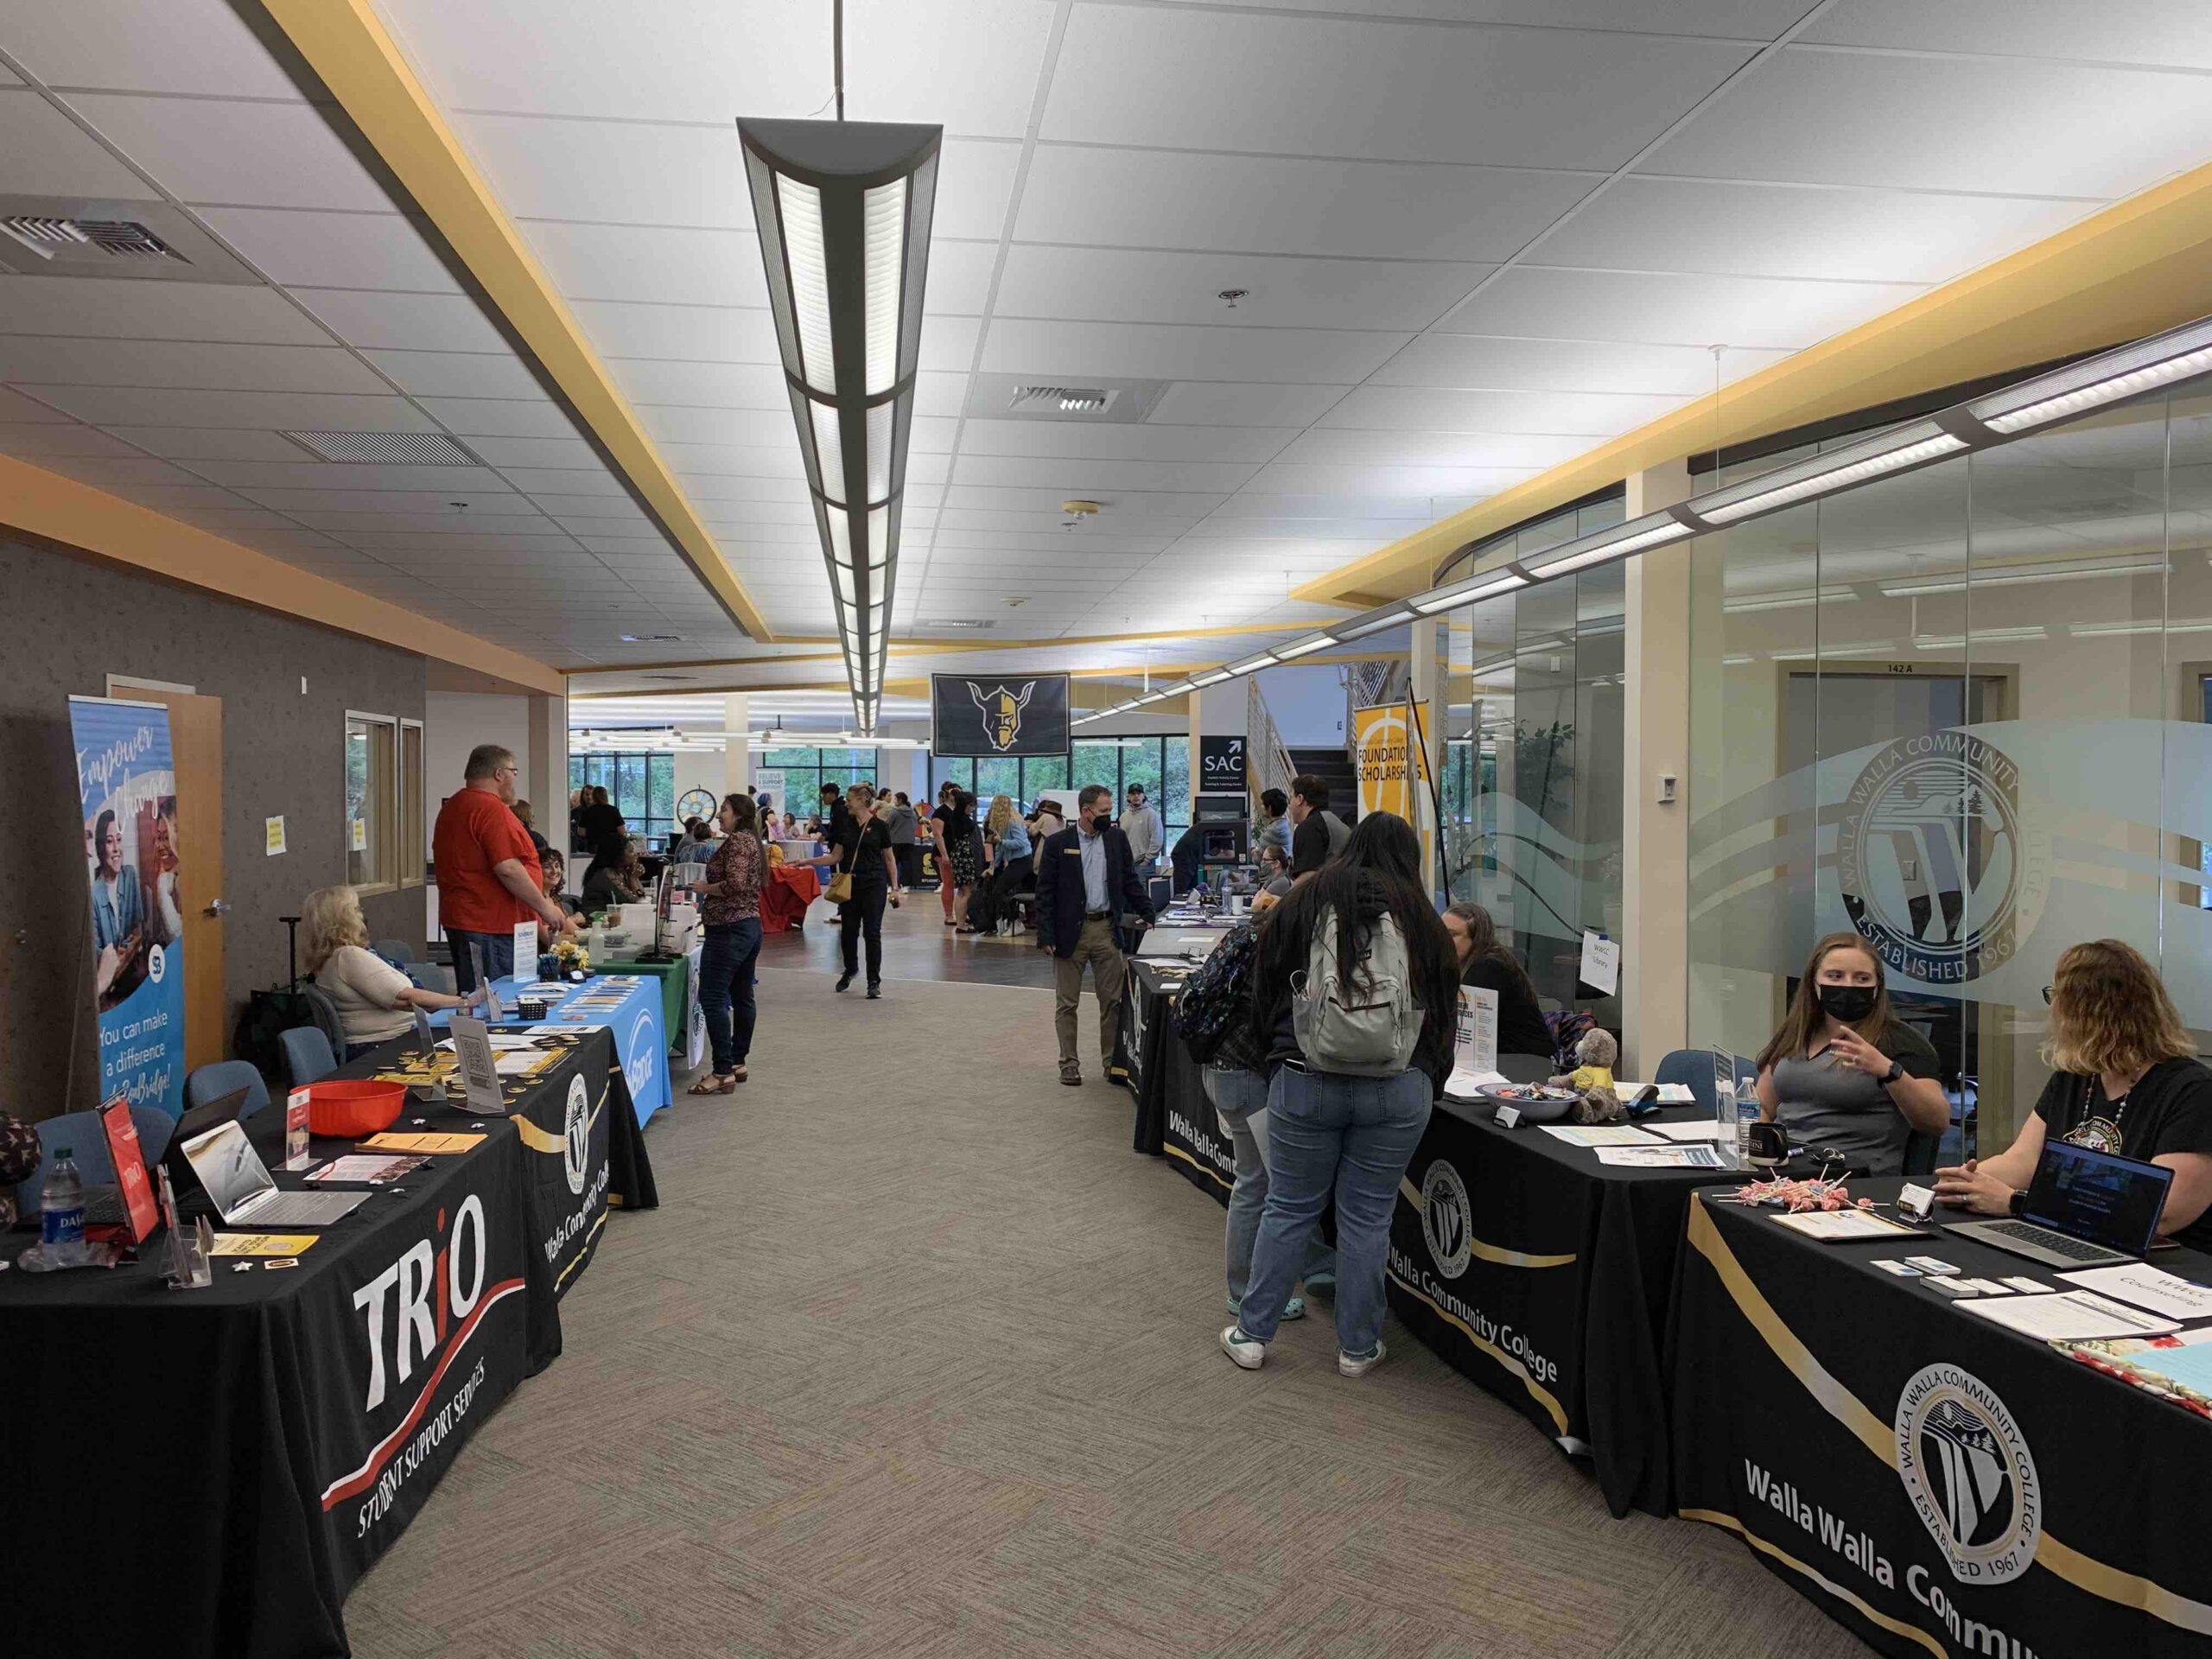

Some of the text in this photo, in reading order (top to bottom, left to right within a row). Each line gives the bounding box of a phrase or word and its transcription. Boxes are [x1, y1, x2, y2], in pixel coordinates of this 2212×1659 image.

[1205, 755, 1243, 772] SAC
[1358, 764, 1422, 781] SCHOLARSHS
[1852, 748, 1904, 805] WALLA
[1906, 734, 2018, 791] COMMUNITY
[1856, 914, 1967, 979] ESTABLISHED
[99, 1009, 168, 1047] You can make
[106, 1042, 166, 1077] a difference
[1169, 1109, 1193, 1143] Walla
[353, 1194, 486, 1413] TRiO
[1422, 1271, 1498, 1345] Community
[1501, 1325, 1558, 1382] College
[358, 1357, 485, 1538] STUDENT SUPPORT SERVICES
[1900, 1370, 2036, 1537] WALLA WALLA COMMUNITY COLLEGE
[1745, 1459, 1814, 1535] Walla
[1818, 1505, 1895, 1590] Walla
[1915, 1494, 2019, 1577] ESTABLISHED 1967
